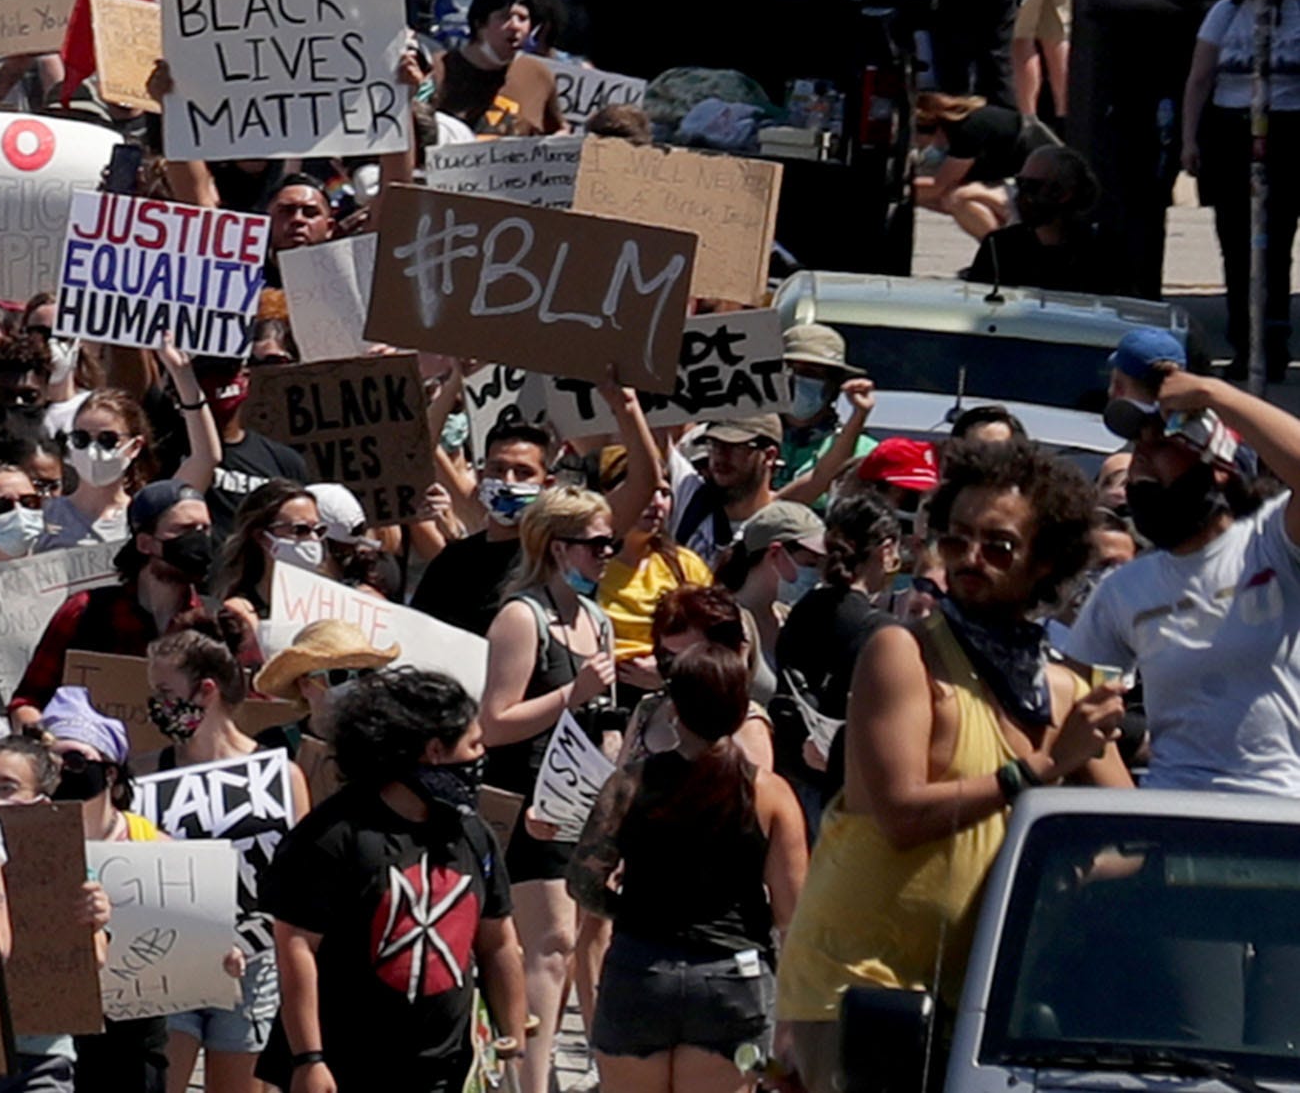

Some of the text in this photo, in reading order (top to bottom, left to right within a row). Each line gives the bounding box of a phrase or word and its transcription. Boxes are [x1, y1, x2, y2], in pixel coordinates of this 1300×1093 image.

[215, 31, 369, 84] LIVES
[185, 80, 402, 148] MATTER
[73, 193, 266, 265] JUSTICE
[63, 239, 266, 315] EQUALITY
[394, 207, 686, 382] #BLM
[56, 287, 257, 356] HUMANITY
[286, 374, 414, 436] BLACK
[277, 578, 401, 648] WHITE
